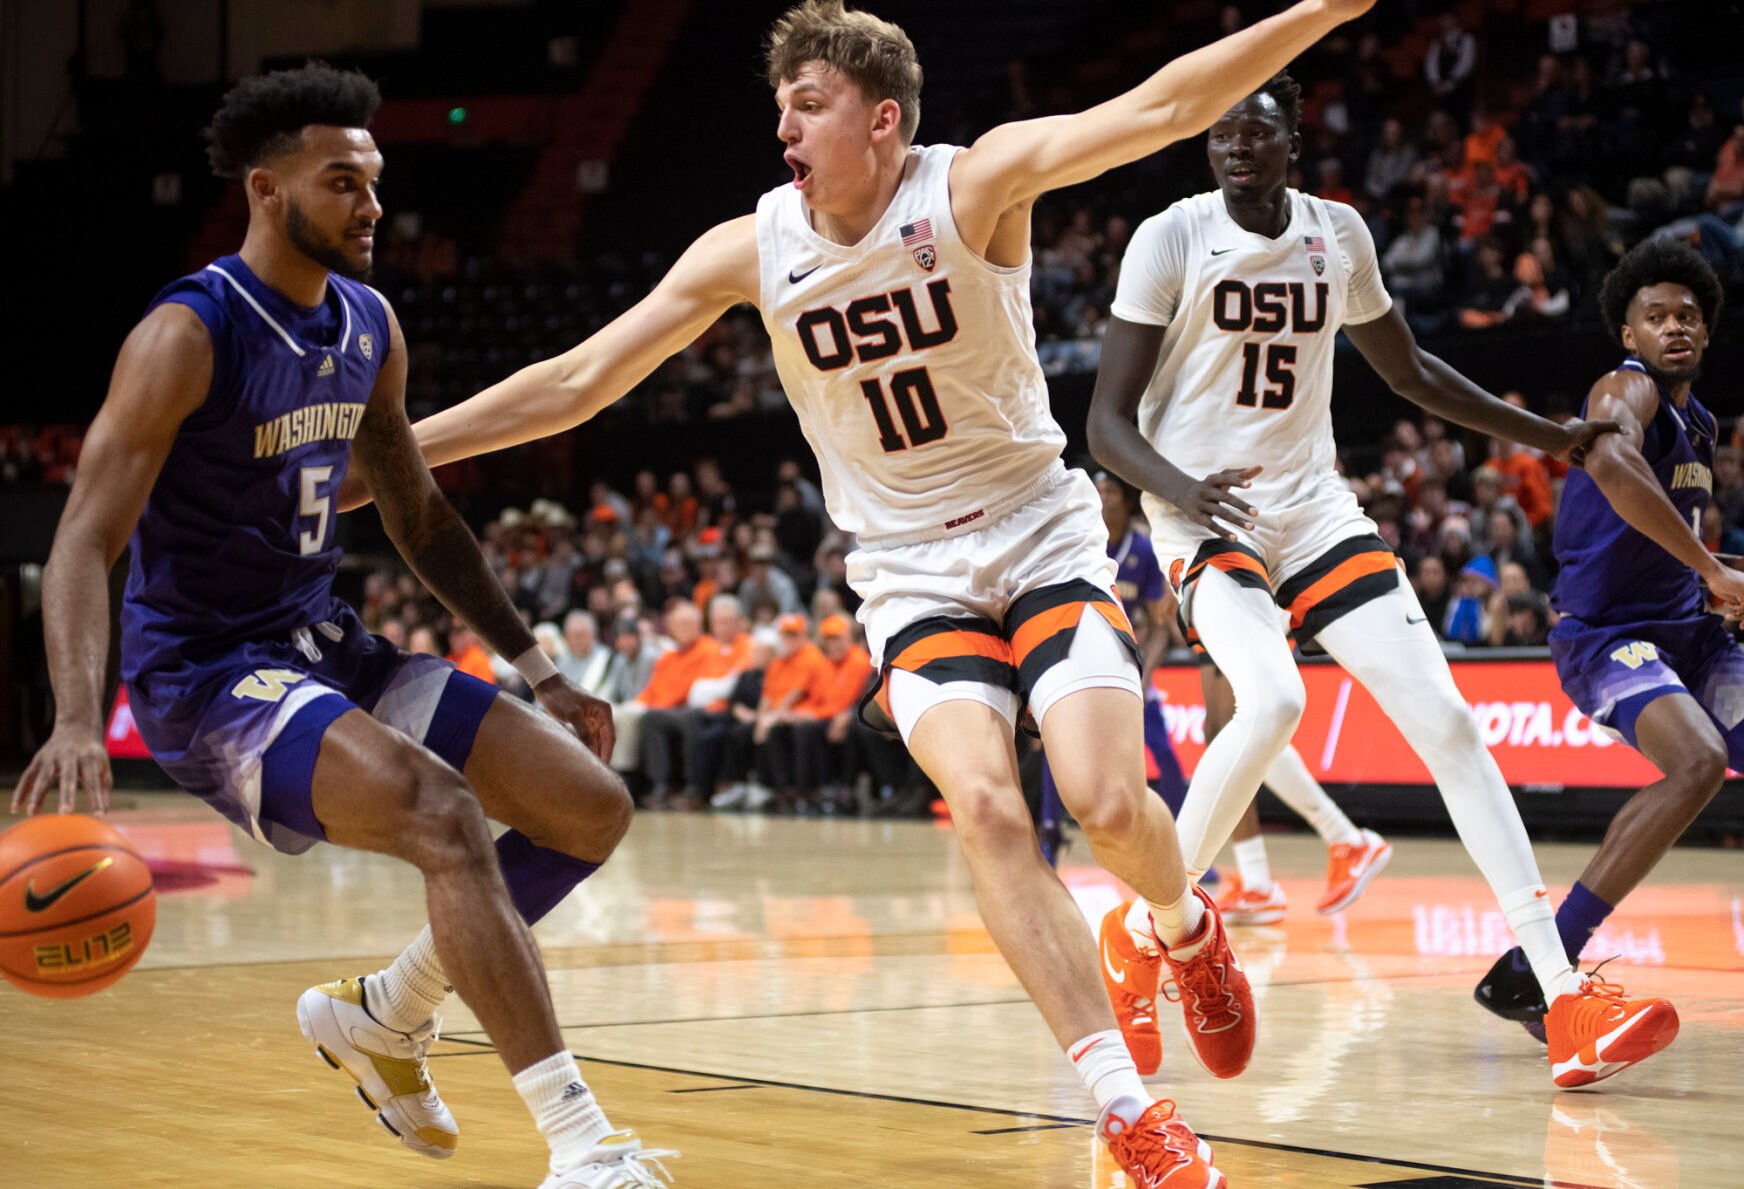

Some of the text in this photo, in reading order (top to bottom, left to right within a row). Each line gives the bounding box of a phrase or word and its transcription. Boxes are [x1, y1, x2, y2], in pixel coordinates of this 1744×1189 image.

[796, 279, 958, 371] OSU
[1214, 280, 1329, 333] OSU
[1236, 342, 1297, 410] 15
[860, 366, 947, 452] 10
[301, 465, 334, 555] 5
[945, 509, 984, 530] BEAVERS
[1610, 641, 1659, 670] W
[35, 922, 132, 968] ELITE
